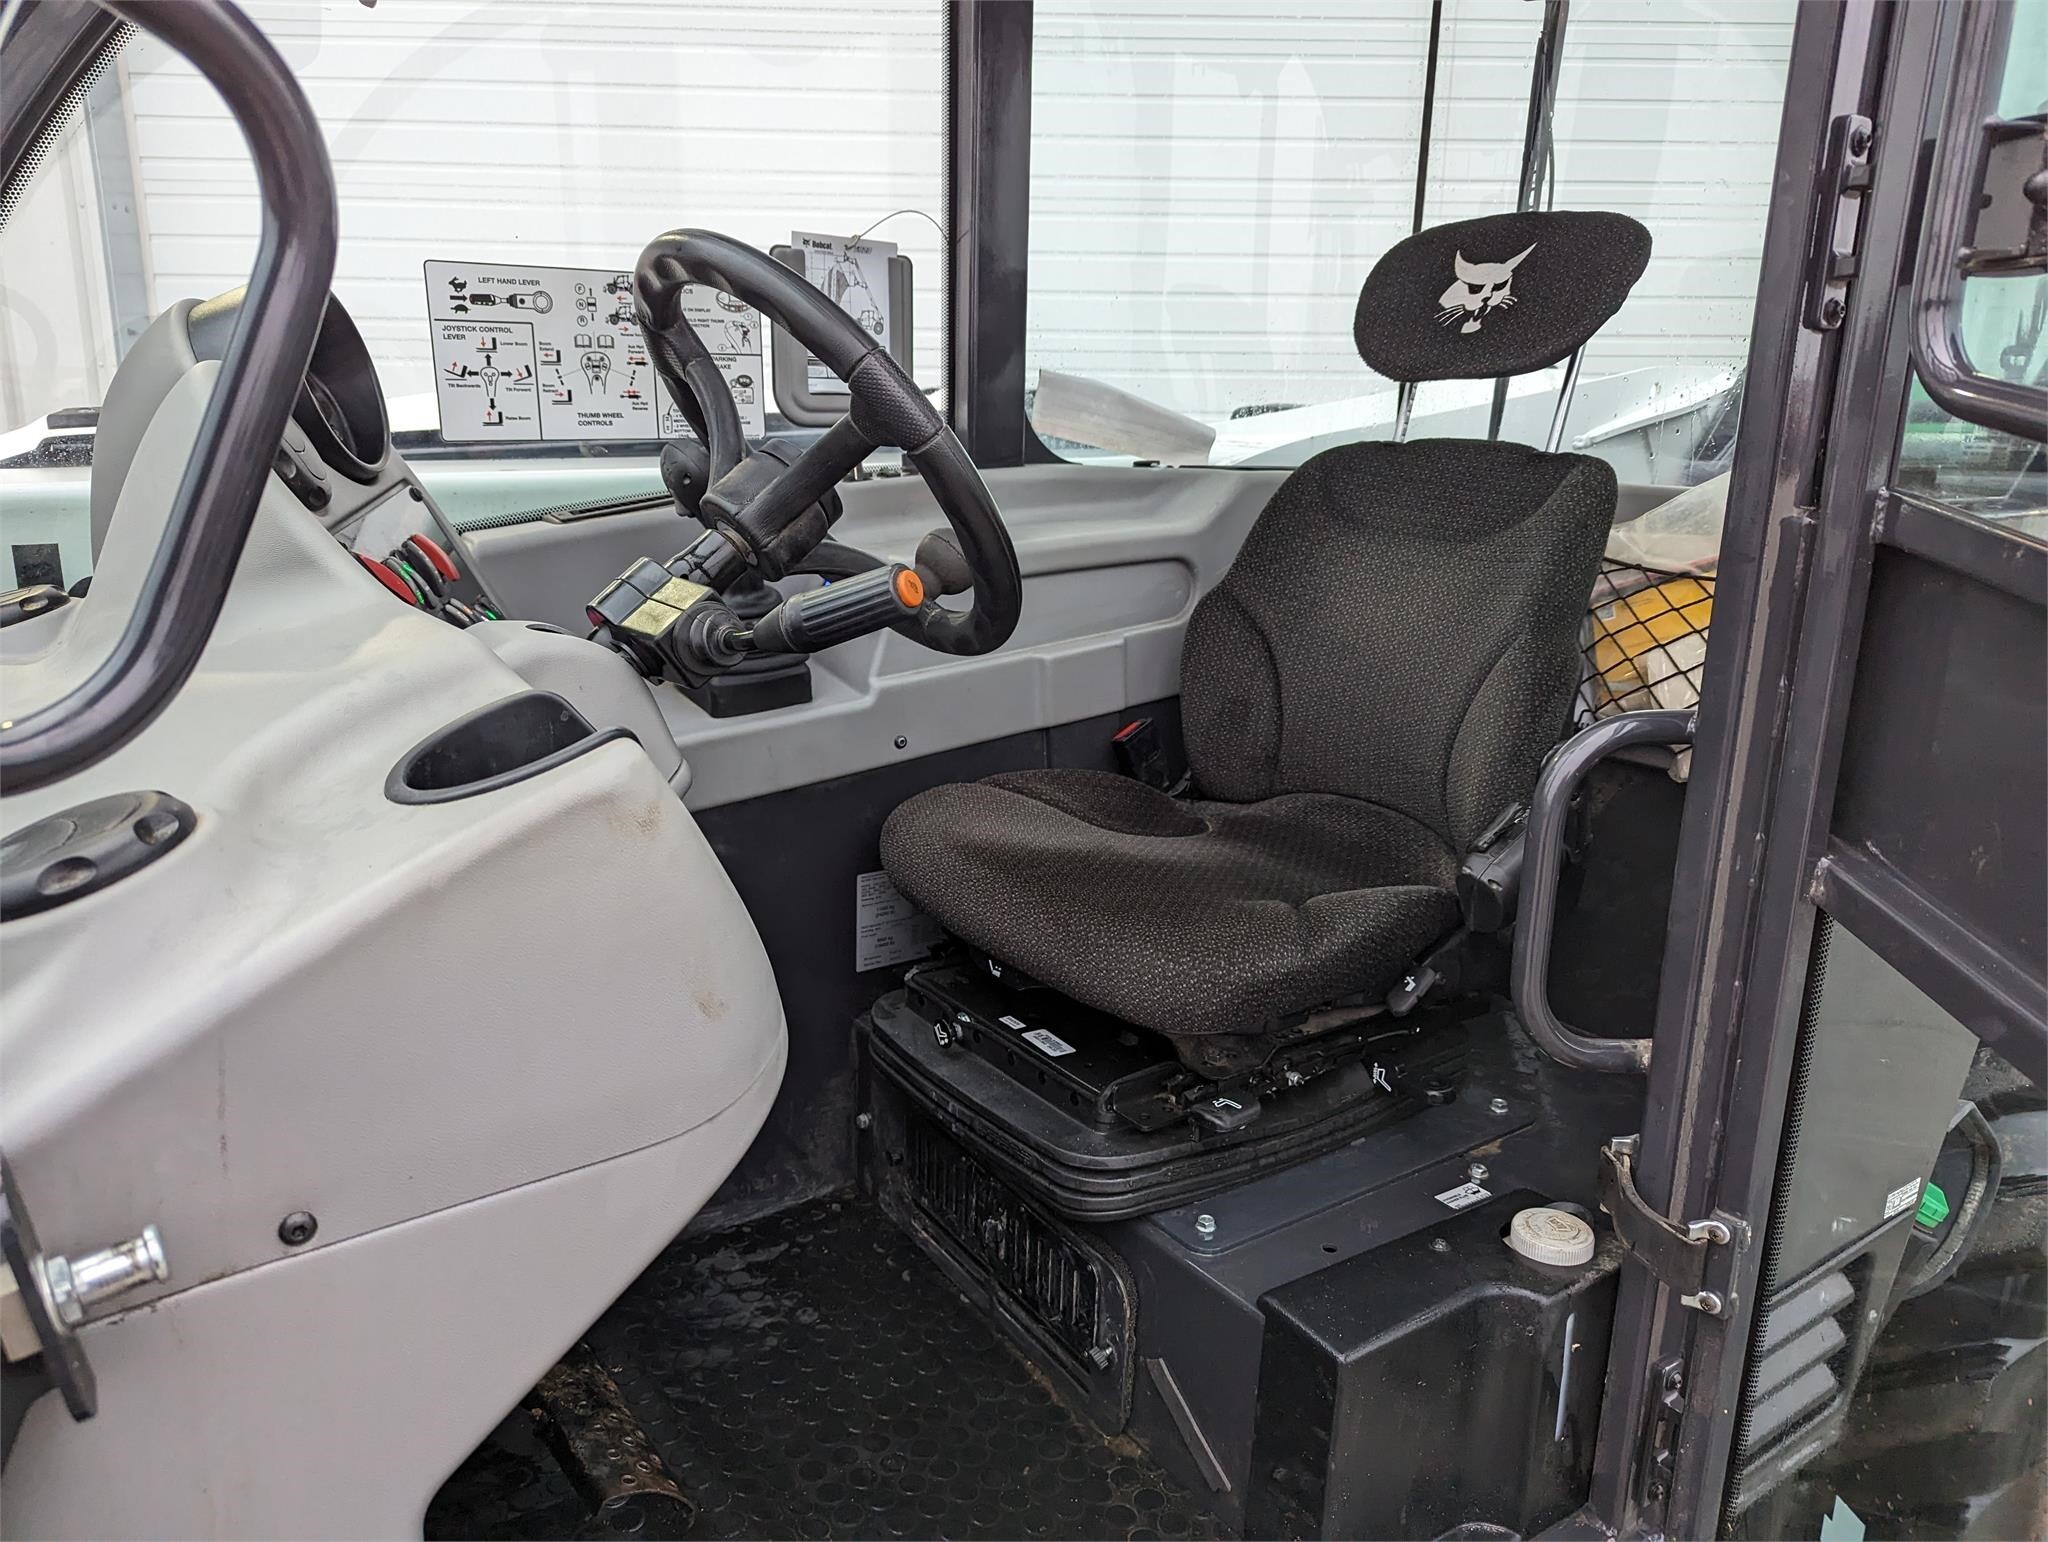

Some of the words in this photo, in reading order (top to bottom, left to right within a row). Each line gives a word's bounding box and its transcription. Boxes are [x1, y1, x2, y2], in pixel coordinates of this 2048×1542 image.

[812, 240, 832, 249] Bobcat
[442, 325, 478, 333] JOYSTICK
[479, 326, 513, 334] CONTROL
[443, 333, 466, 341] LEVER
